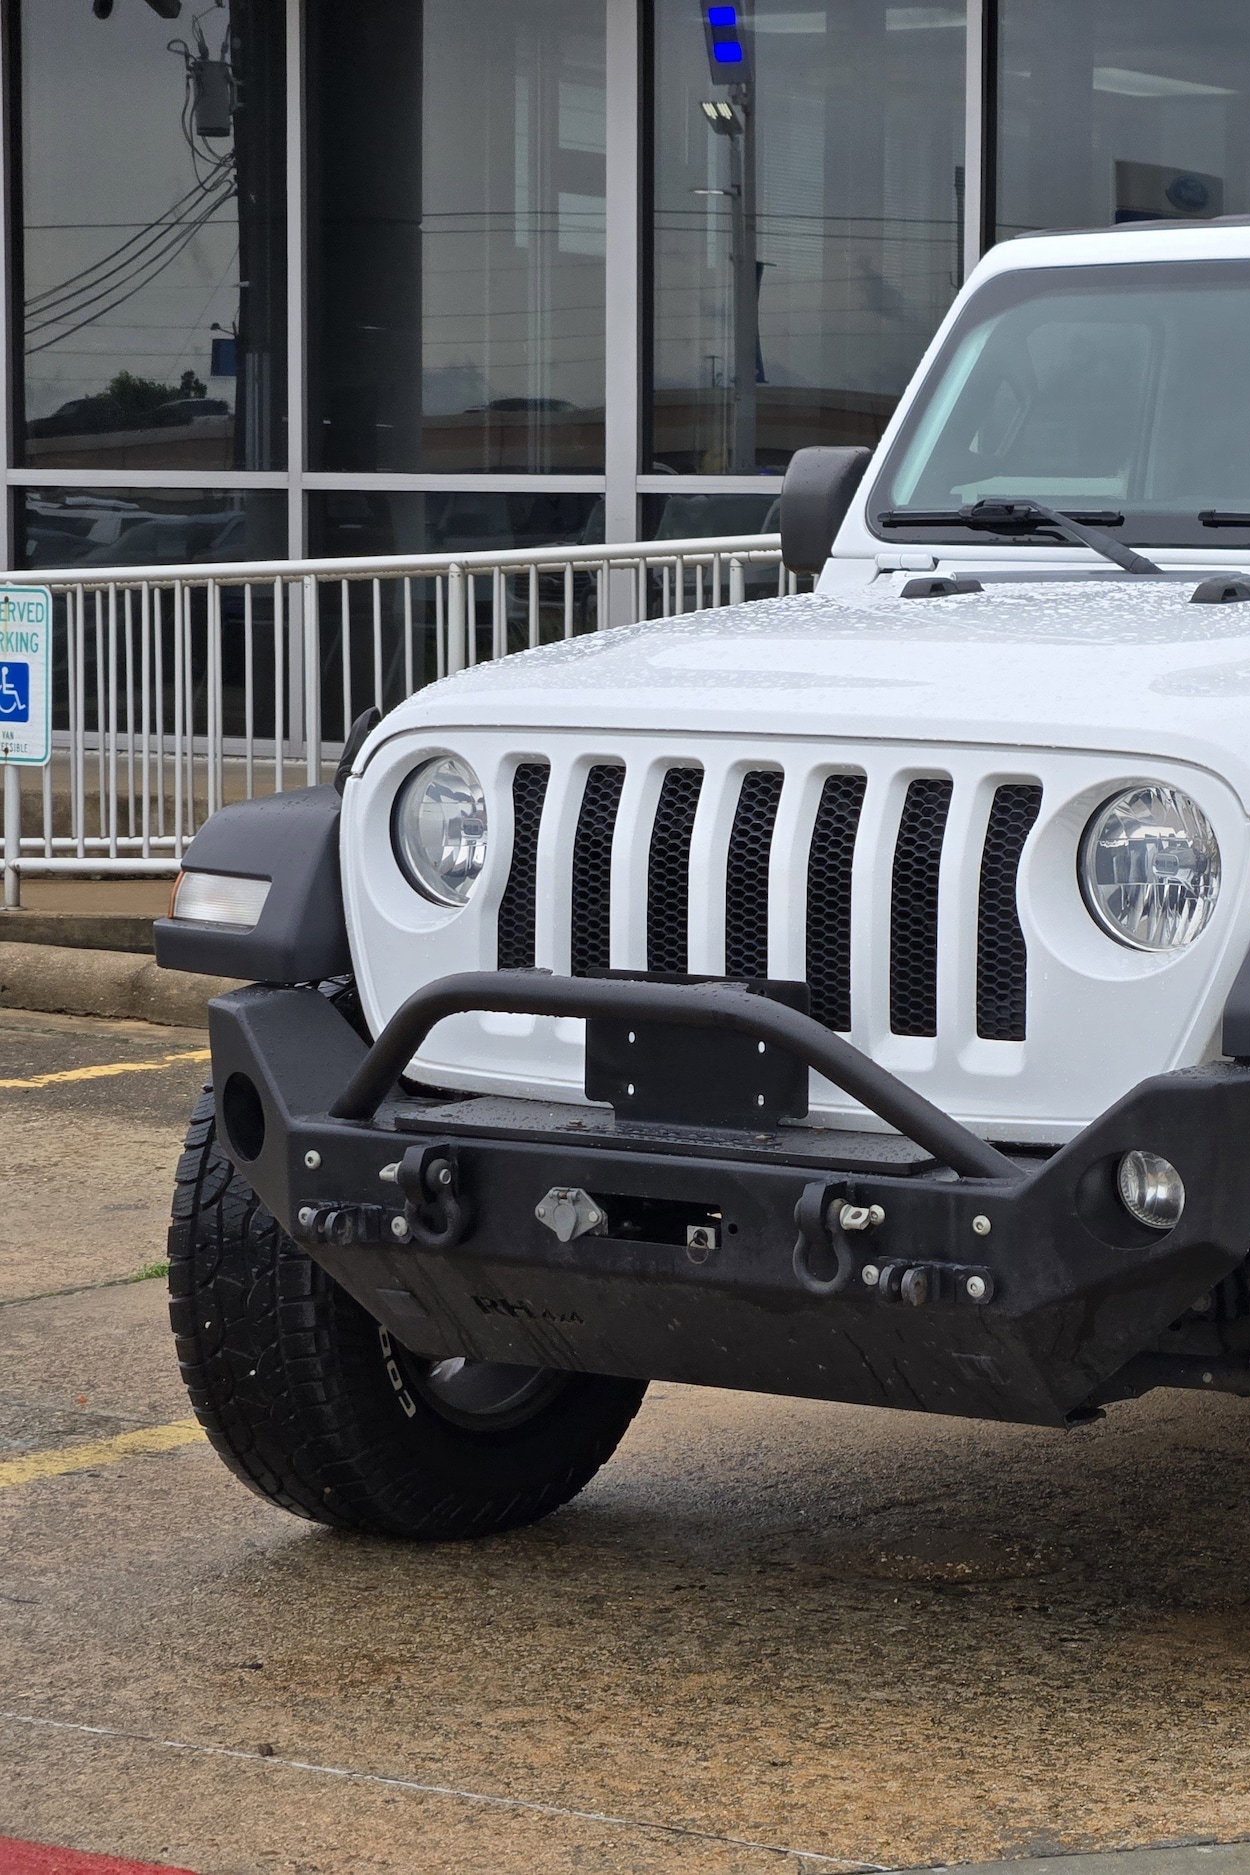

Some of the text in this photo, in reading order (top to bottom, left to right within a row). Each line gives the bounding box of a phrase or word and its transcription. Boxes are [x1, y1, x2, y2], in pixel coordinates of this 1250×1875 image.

[0, 601, 44, 623] ERVED
[0, 631, 39, 653] RKING
[2, 731, 14, 740] VAN
[0, 742, 28, 753] ESIBLE
[378, 1325, 417, 1418] COO
